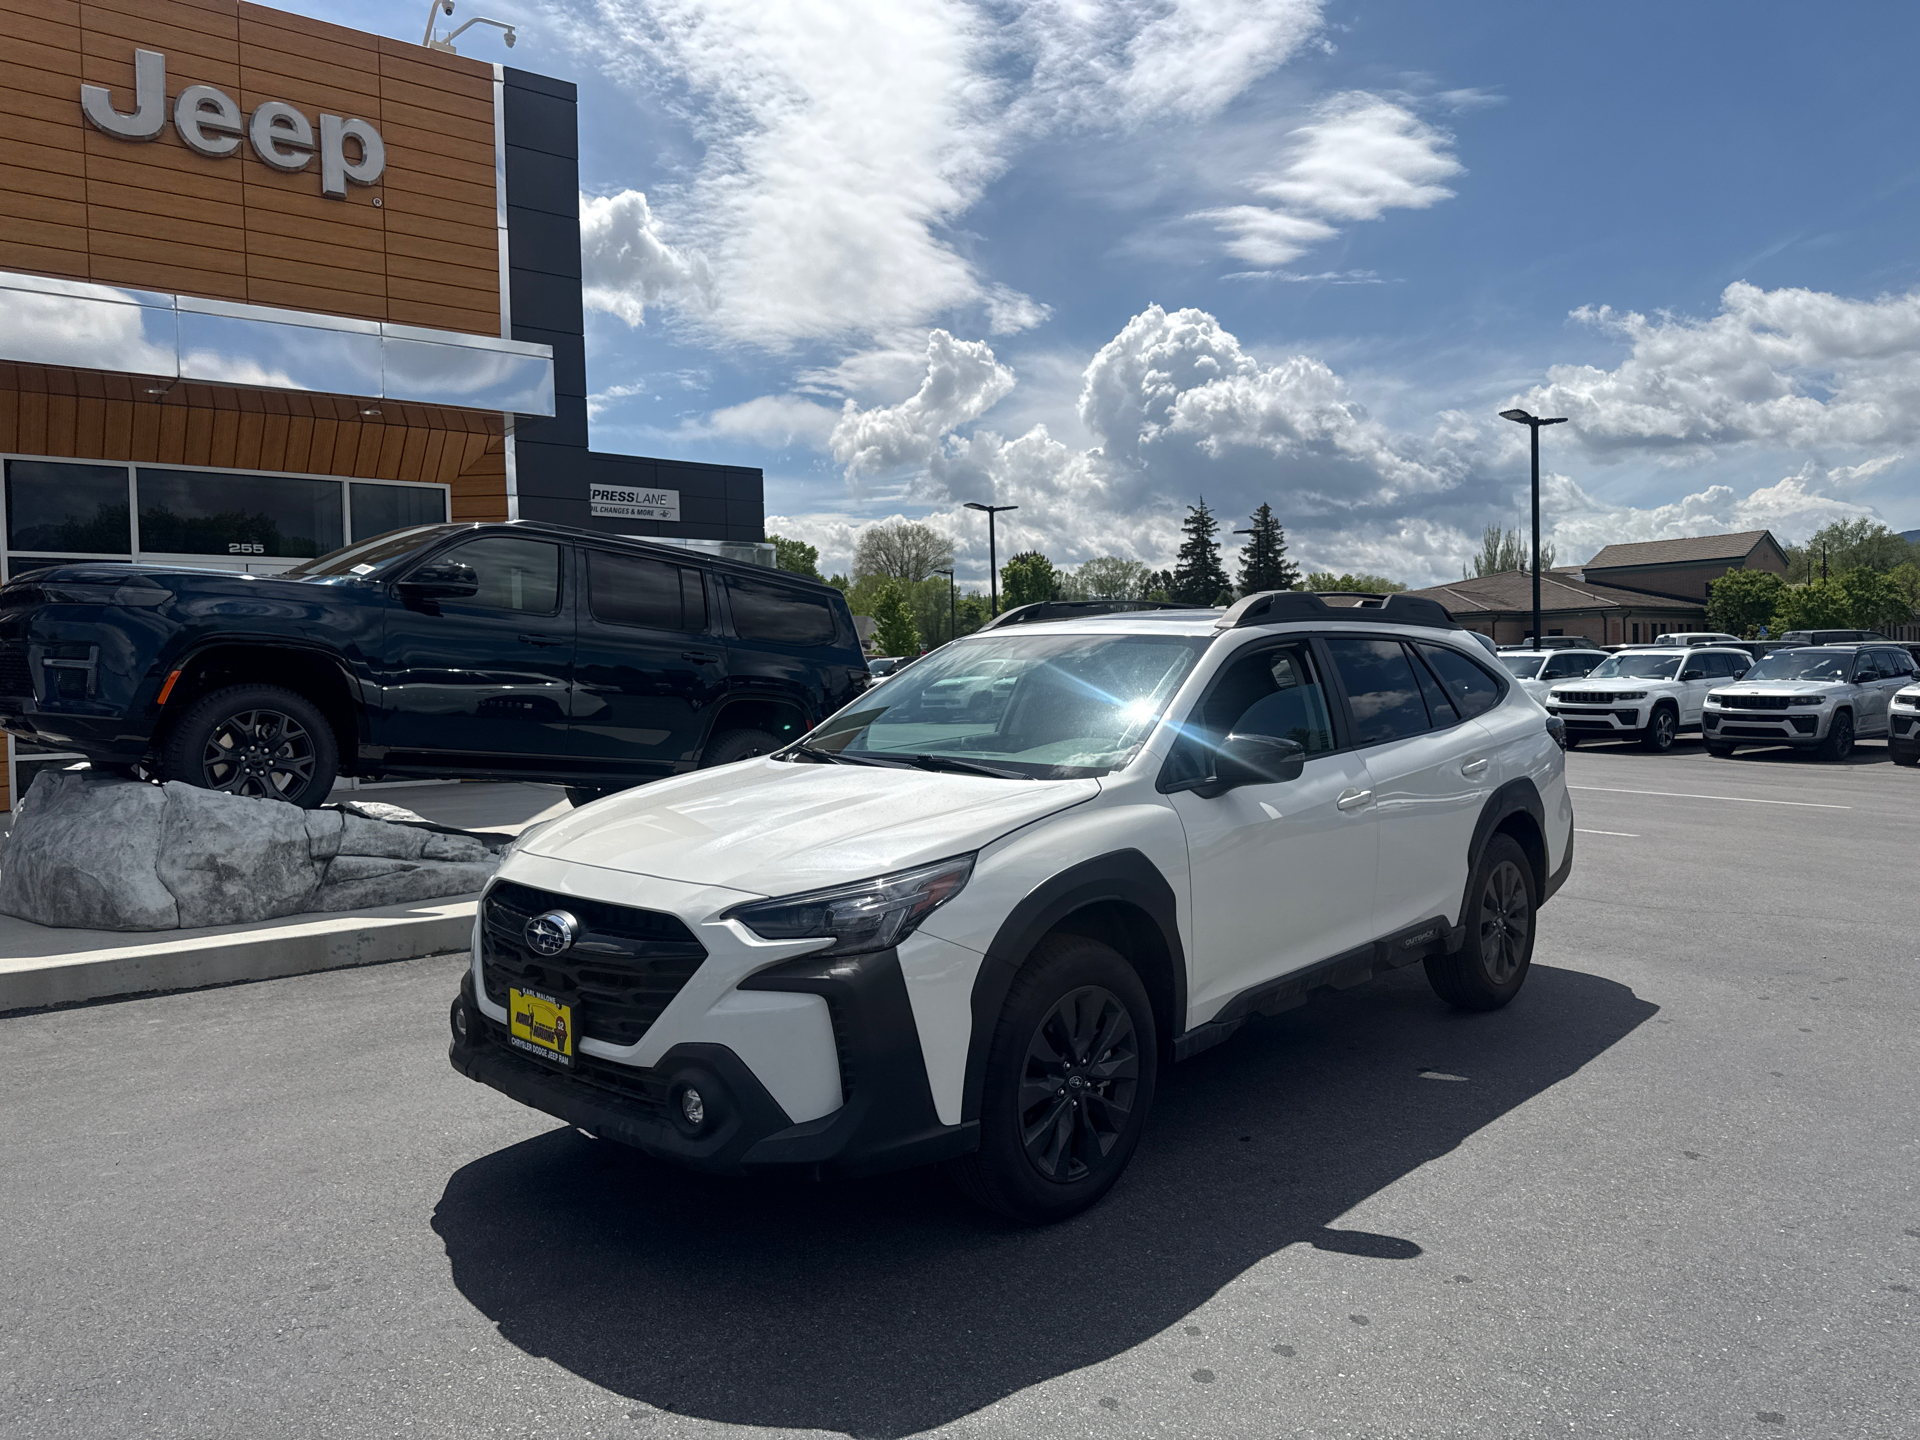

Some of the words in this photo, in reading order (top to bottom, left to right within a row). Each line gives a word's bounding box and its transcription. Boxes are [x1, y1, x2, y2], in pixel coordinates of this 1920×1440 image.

[81, 48, 386, 200] Jeep
[590, 489, 668, 505] PRESSLANE
[599, 506, 629, 515] CHANGES
[228, 542, 265, 554] 255
[1404, 929, 1434, 946] OUTBACK
[522, 987, 536, 998] KARL
[536, 992, 557, 1004] MALONE
[557, 1020, 565, 1031] 32
[511, 1037, 532, 1052] CHRYSLER
[532, 1045, 548, 1057] DODGE
[547, 1050, 559, 1061] JEEP
[558, 1054, 569, 1065] RAM
